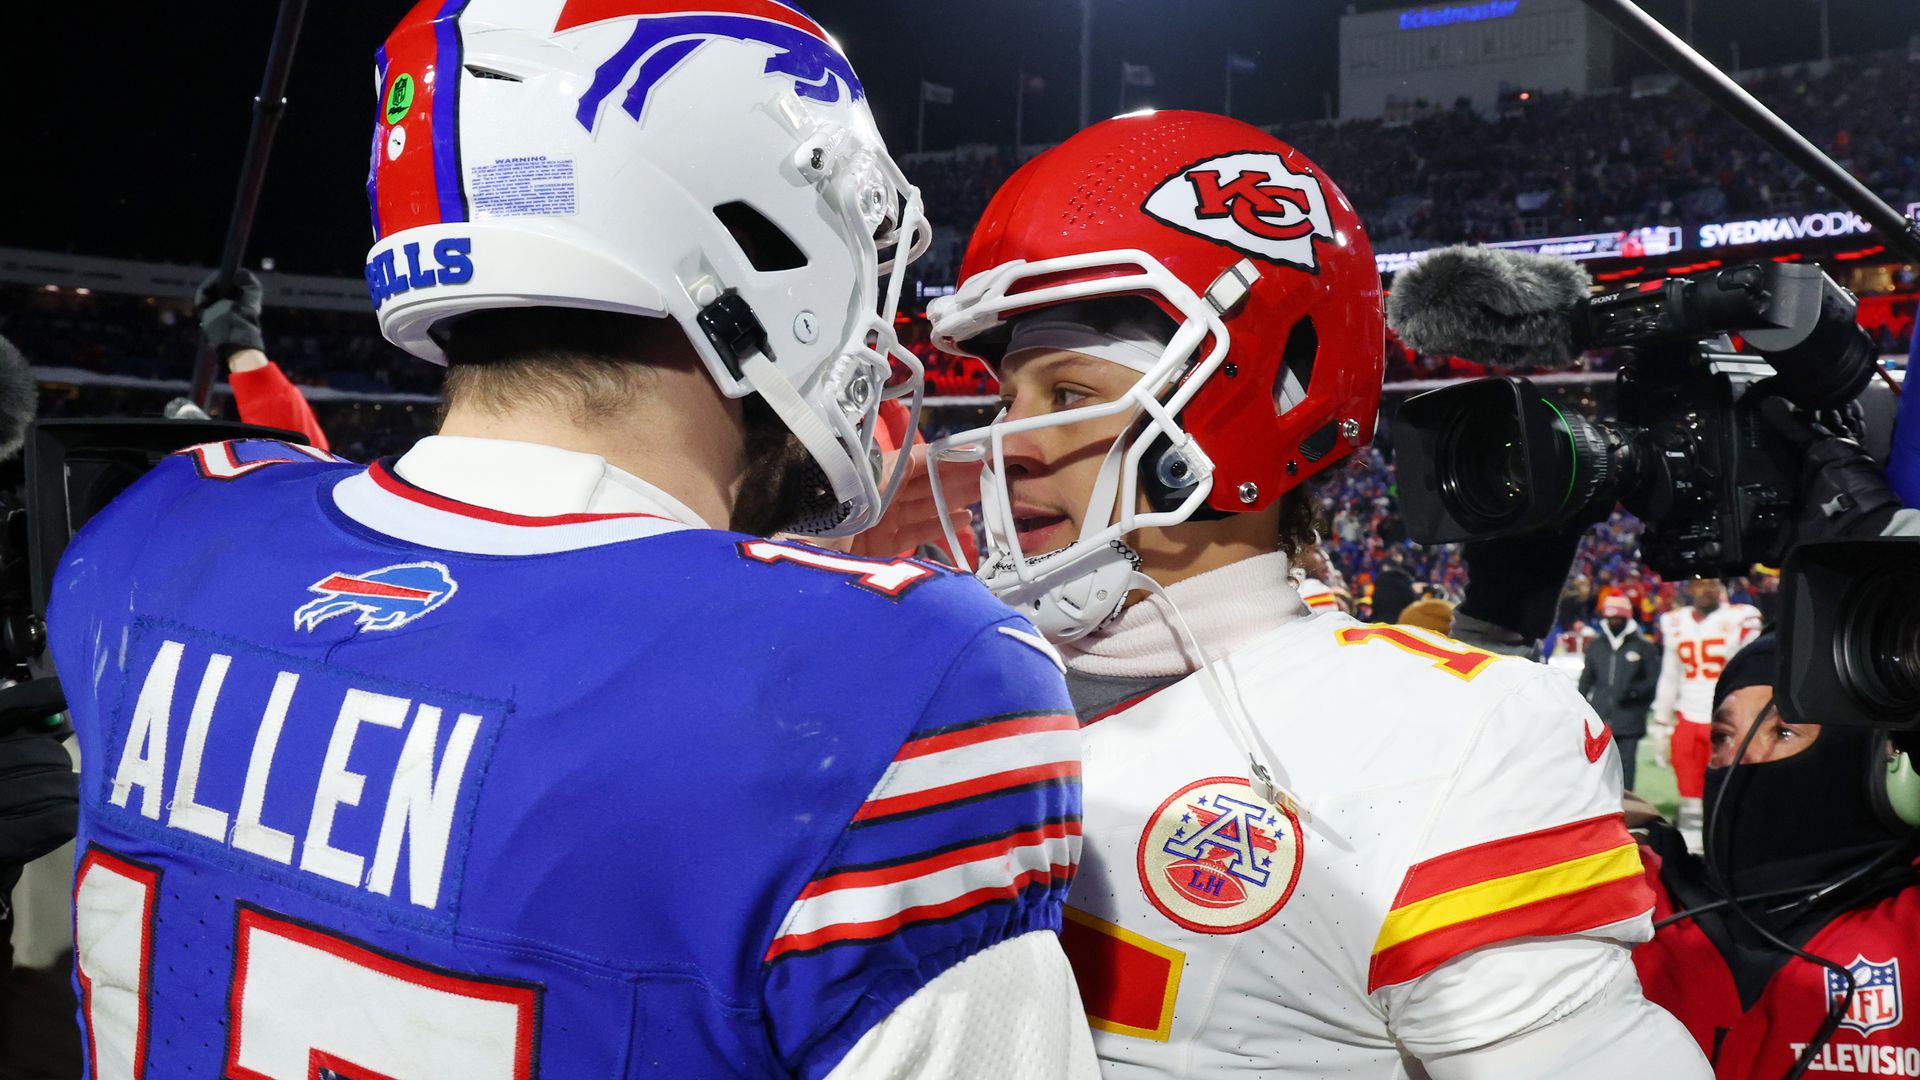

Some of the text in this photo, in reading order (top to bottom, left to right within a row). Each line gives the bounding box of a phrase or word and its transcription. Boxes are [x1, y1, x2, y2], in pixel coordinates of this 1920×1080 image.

[495, 155, 547, 165] WARNING
[1185, 169, 1315, 240] KC
[1590, 292, 1620, 305] SONY
[1677, 638, 1727, 679] 95
[107, 640, 483, 910] ALLEN
[1188, 868, 1224, 896] LH
